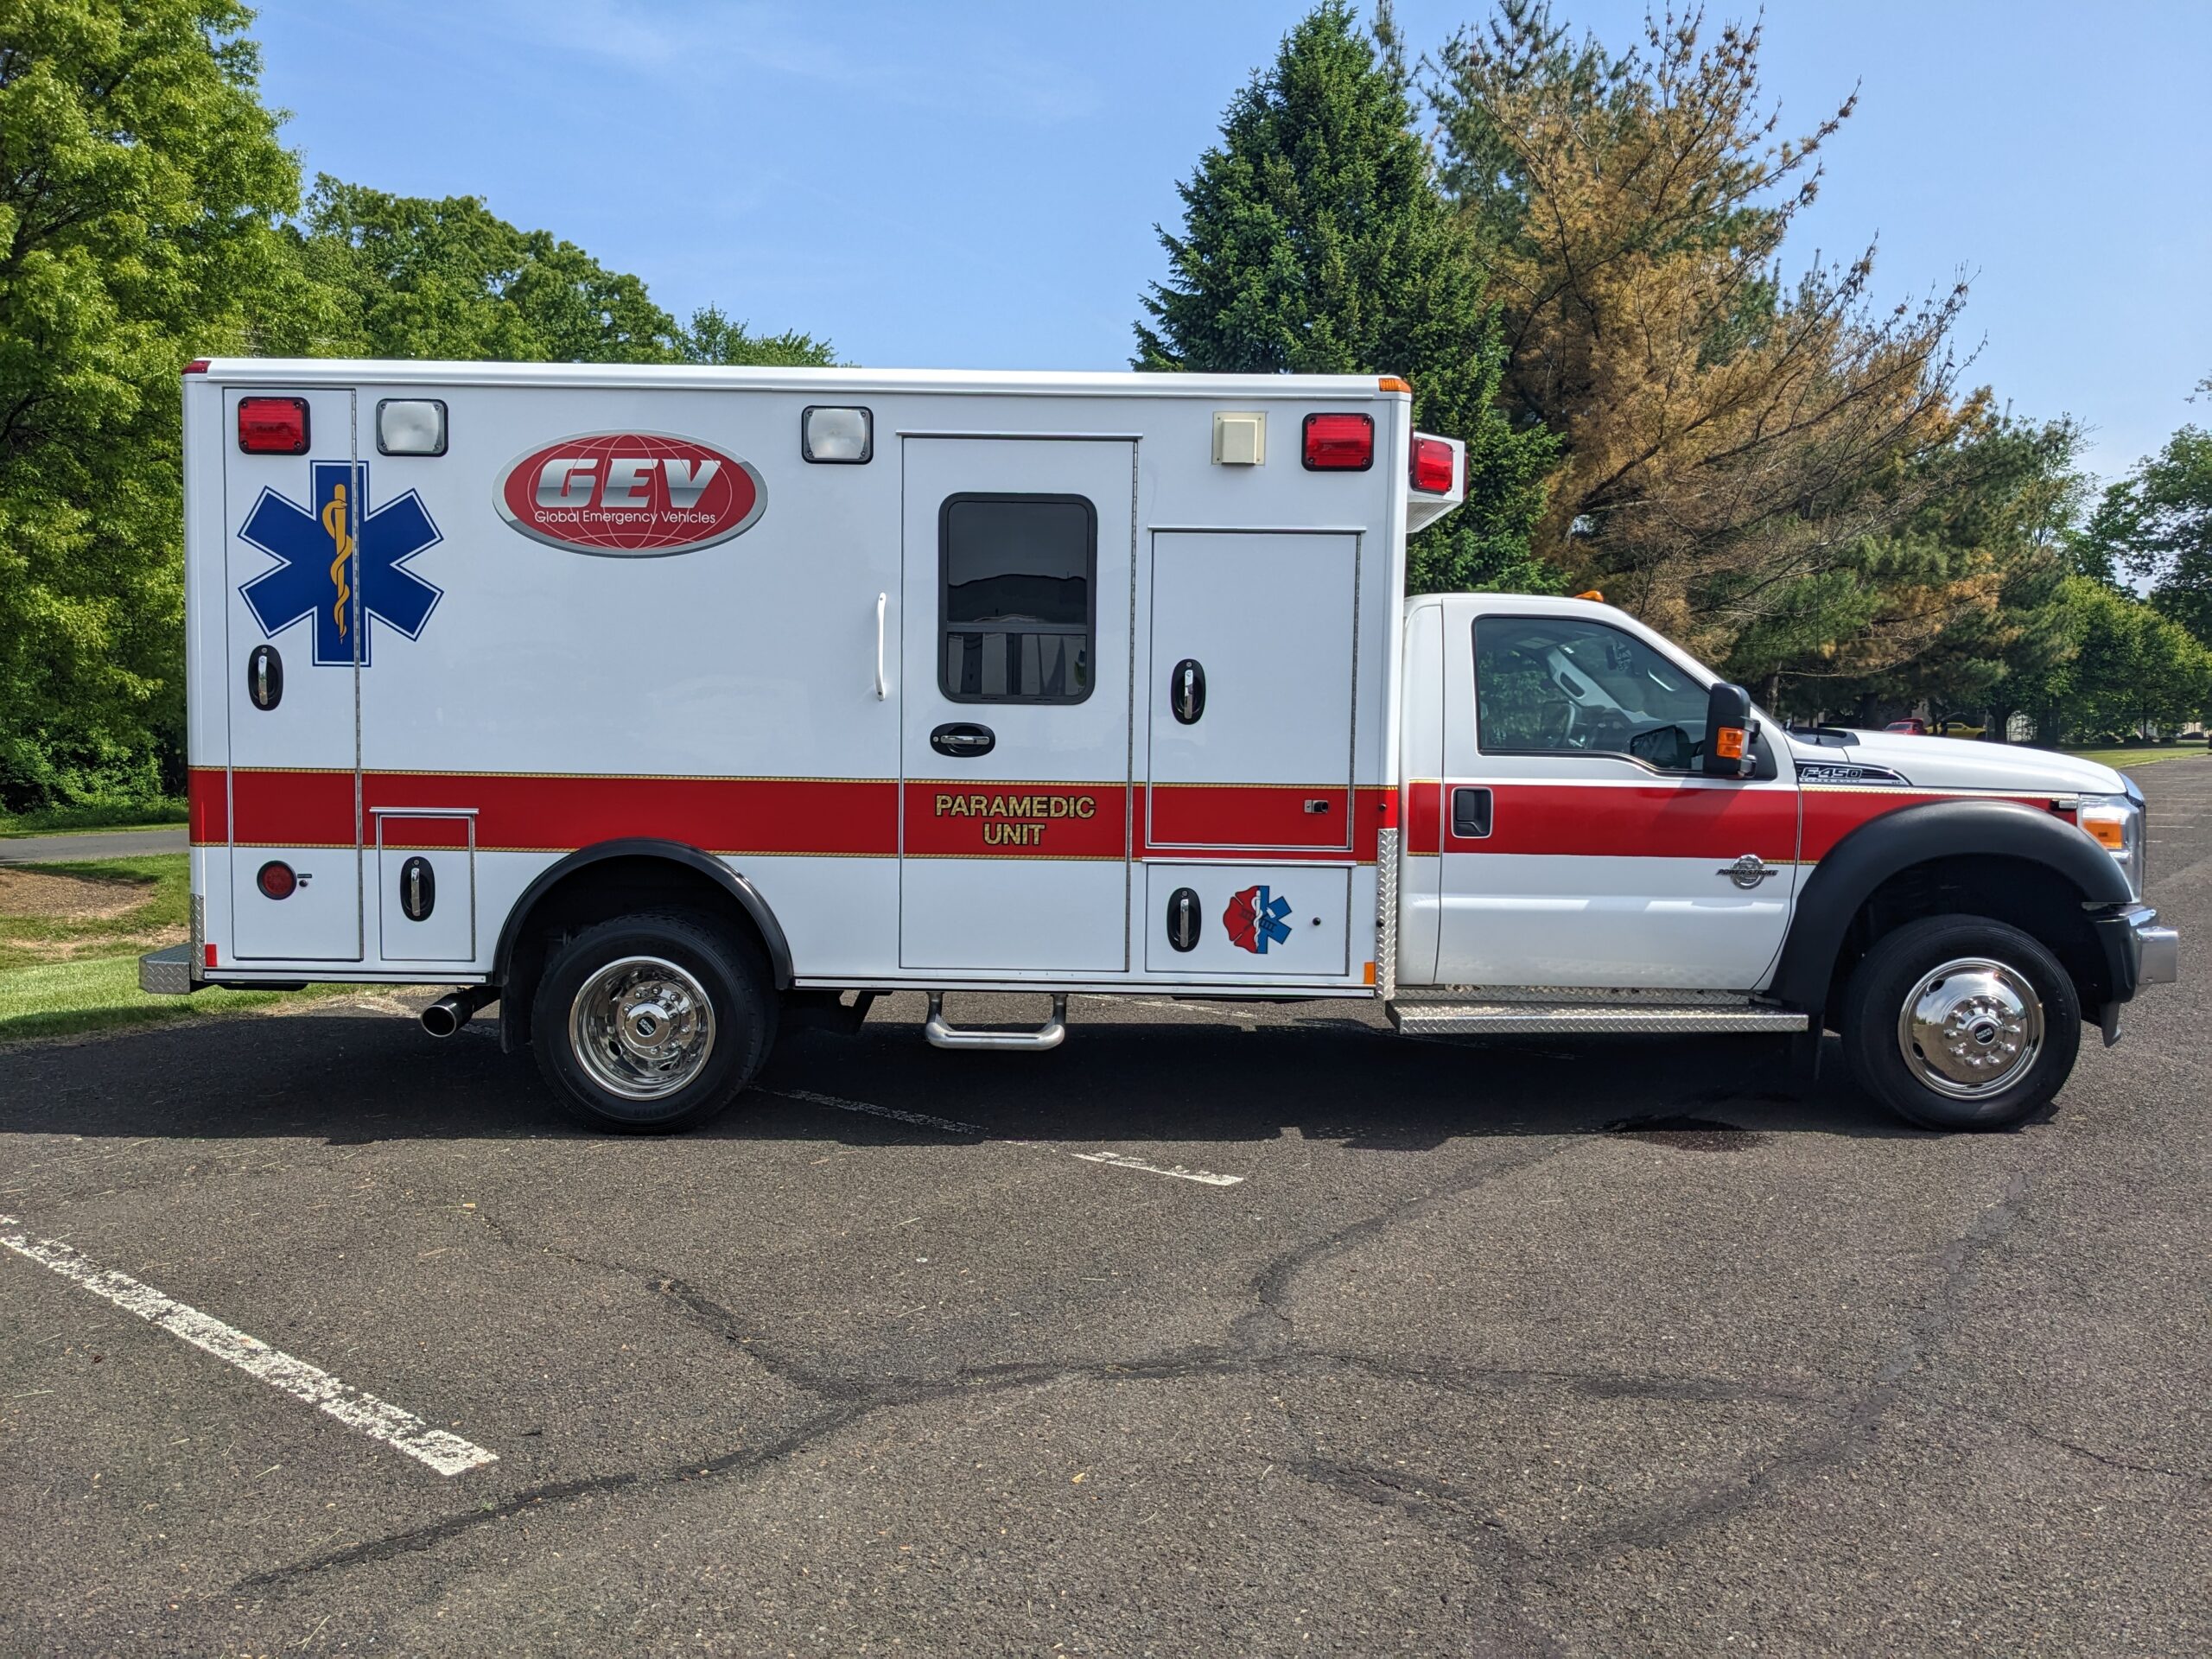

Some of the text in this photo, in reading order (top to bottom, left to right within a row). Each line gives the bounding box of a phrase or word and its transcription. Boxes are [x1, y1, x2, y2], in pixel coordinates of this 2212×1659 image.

[535, 458, 721, 509] GEV
[534, 511, 716, 525] Global Emergency Vehicles
[1800, 766, 1863, 779] F-450
[935, 794, 1096, 818] PARAMEDIC
[983, 823, 1046, 845] UNIT
